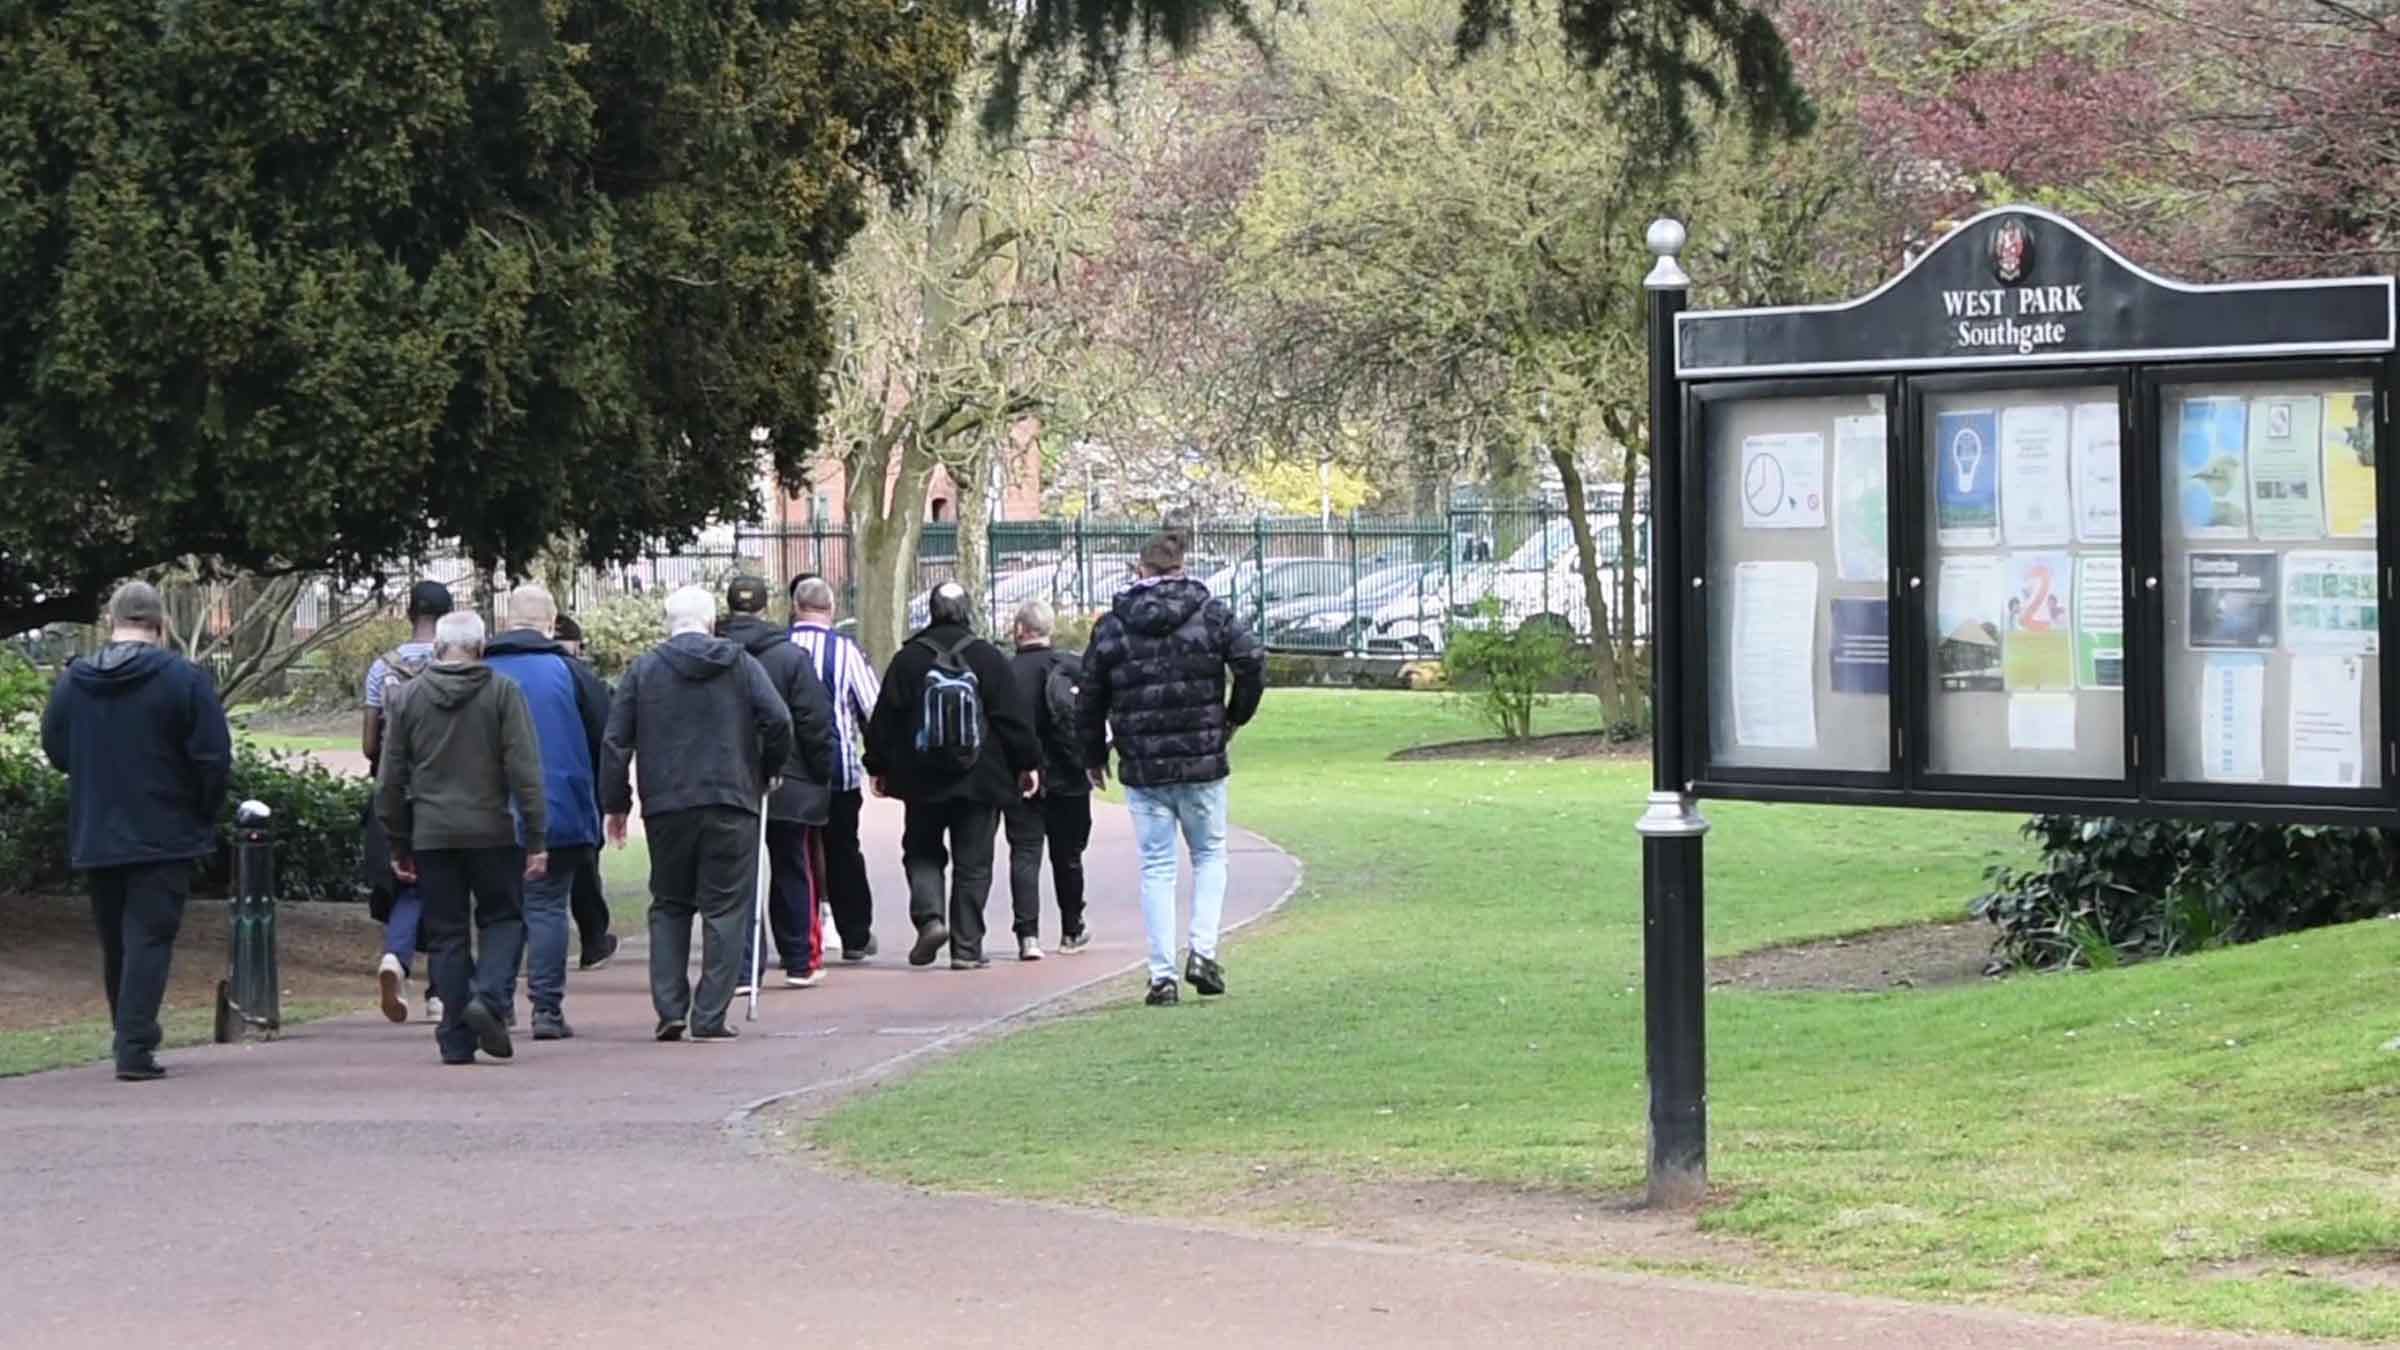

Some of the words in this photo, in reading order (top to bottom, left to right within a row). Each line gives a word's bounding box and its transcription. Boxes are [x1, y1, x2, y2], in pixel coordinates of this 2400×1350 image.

[1943, 289, 2005, 316] WEST
[2018, 285, 2083, 314] PARK
[1957, 318, 2066, 354] Southgate
